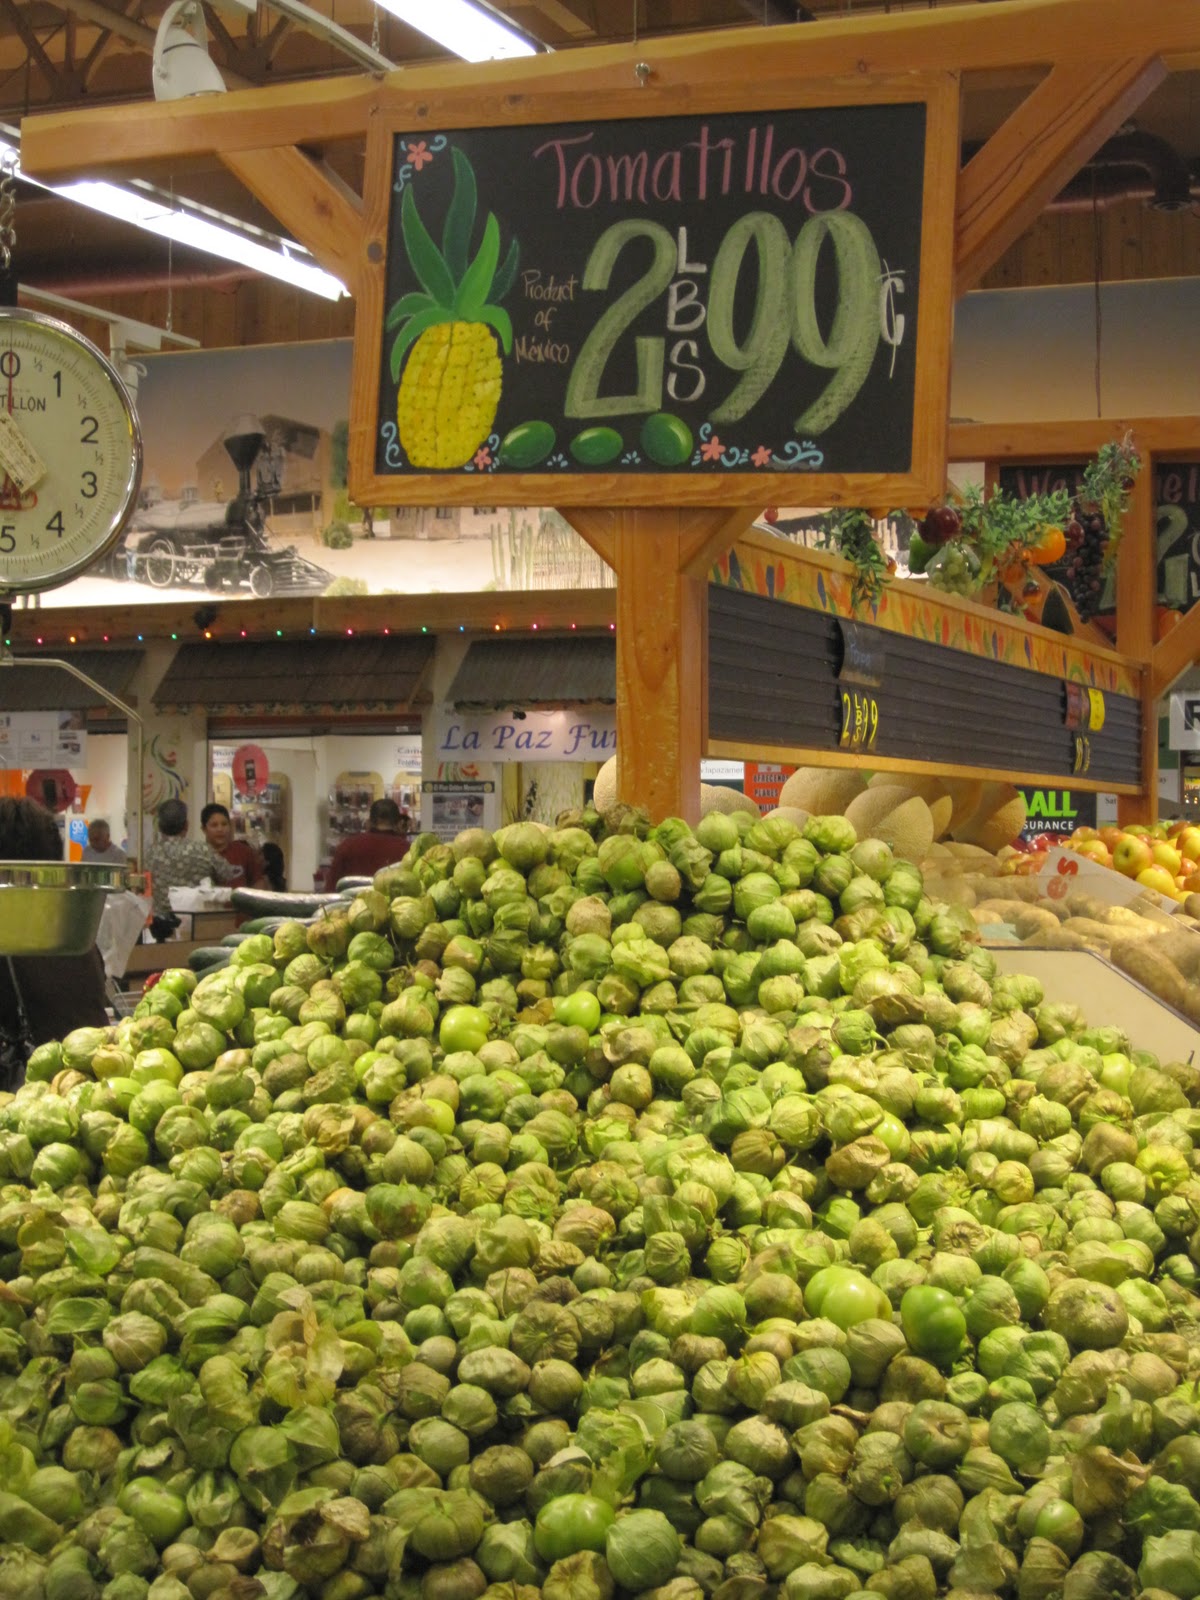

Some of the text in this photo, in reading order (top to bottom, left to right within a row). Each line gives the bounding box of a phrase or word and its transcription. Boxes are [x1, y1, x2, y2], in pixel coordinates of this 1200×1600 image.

[535, 125, 853, 215] Tomatillos
[522, 268, 578, 302] Product
[534, 306, 557, 332] of
[564, 218, 677, 419] 2
[53, 371, 62, 398] 1
[0, 394, 47, 412] TLLON
[80, 416, 99, 444] 2
[80, 471, 98, 499] 3
[46, 510, 65, 538] 4
[0, 525, 17, 553] 5
[441, 725, 482, 751] La
[493, 724, 553, 751] Paz
